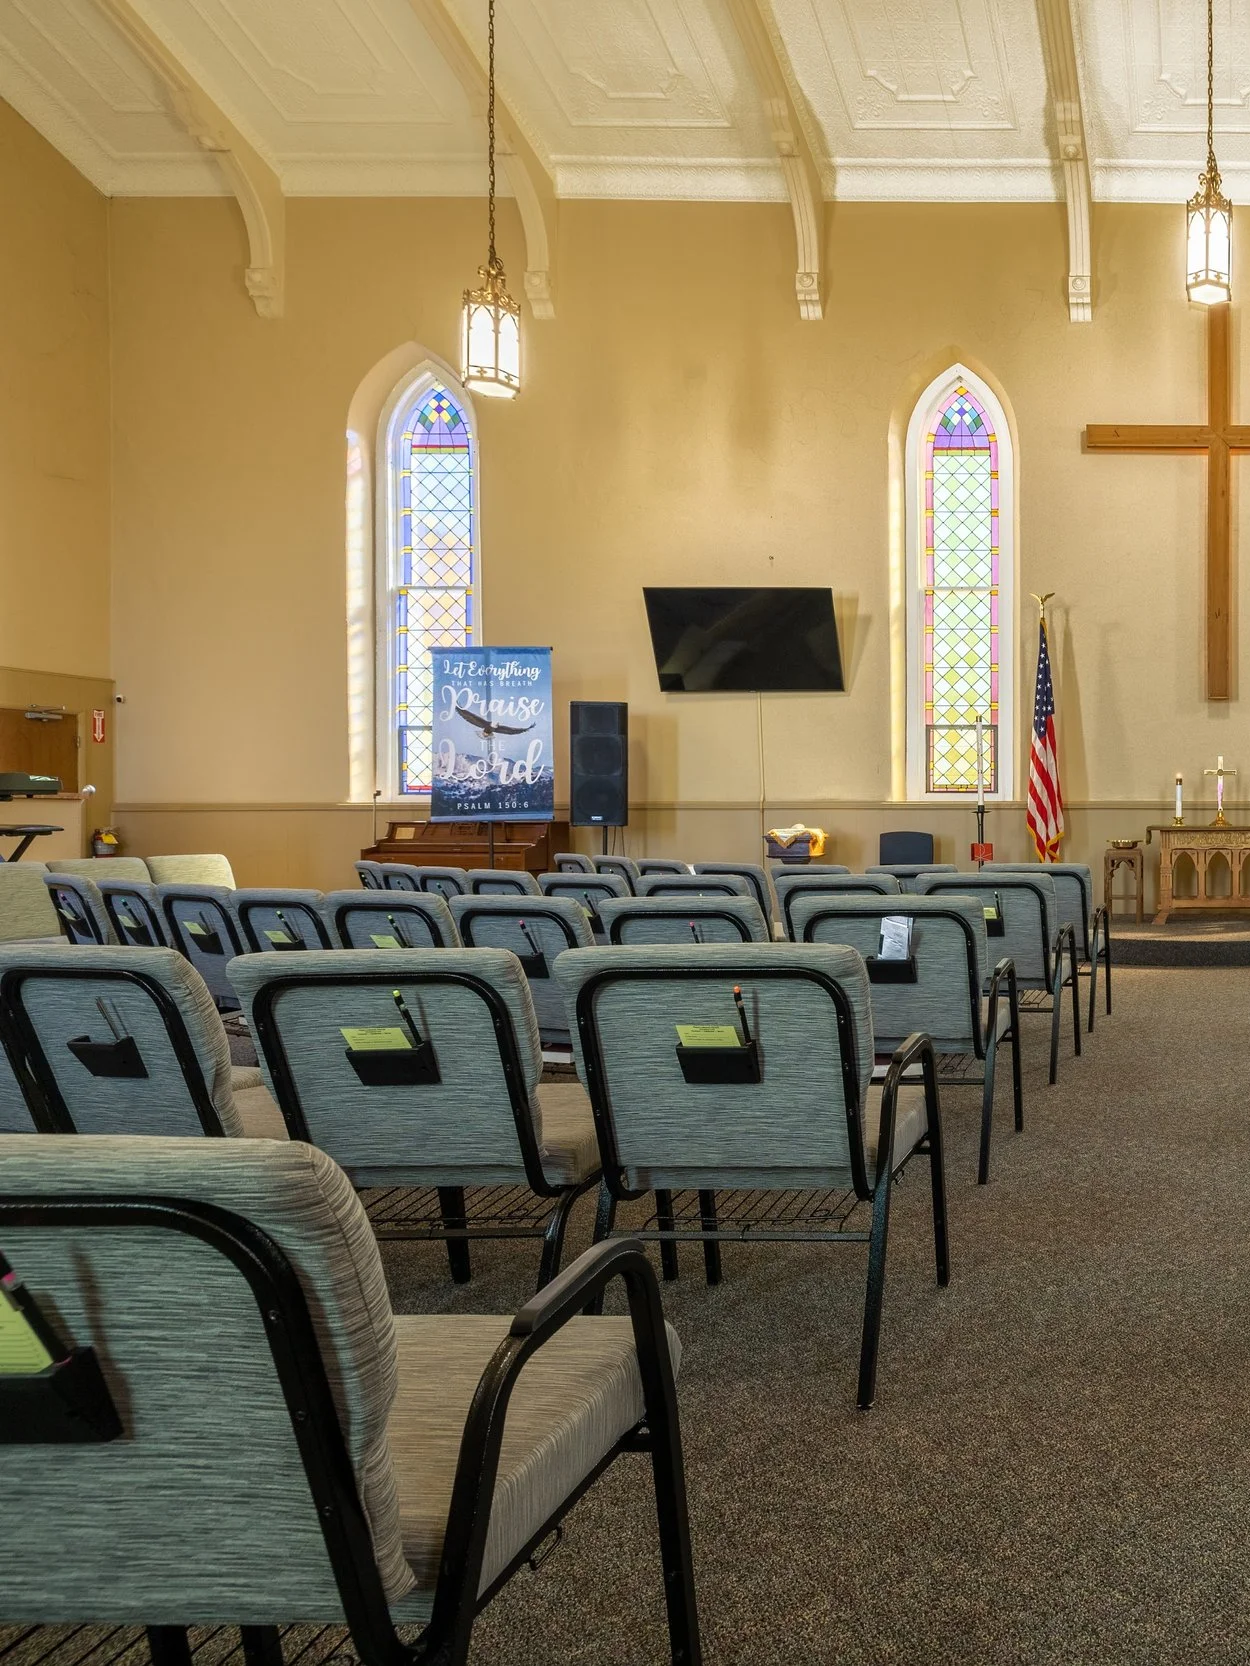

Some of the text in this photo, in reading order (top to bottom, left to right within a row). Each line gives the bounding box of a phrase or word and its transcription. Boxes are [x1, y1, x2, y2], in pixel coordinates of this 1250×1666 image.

[444, 660, 541, 681] Let Everything
[440, 686, 545, 722] Praise
[480, 740, 505, 752] THE
[438, 738, 545, 785] Lord
